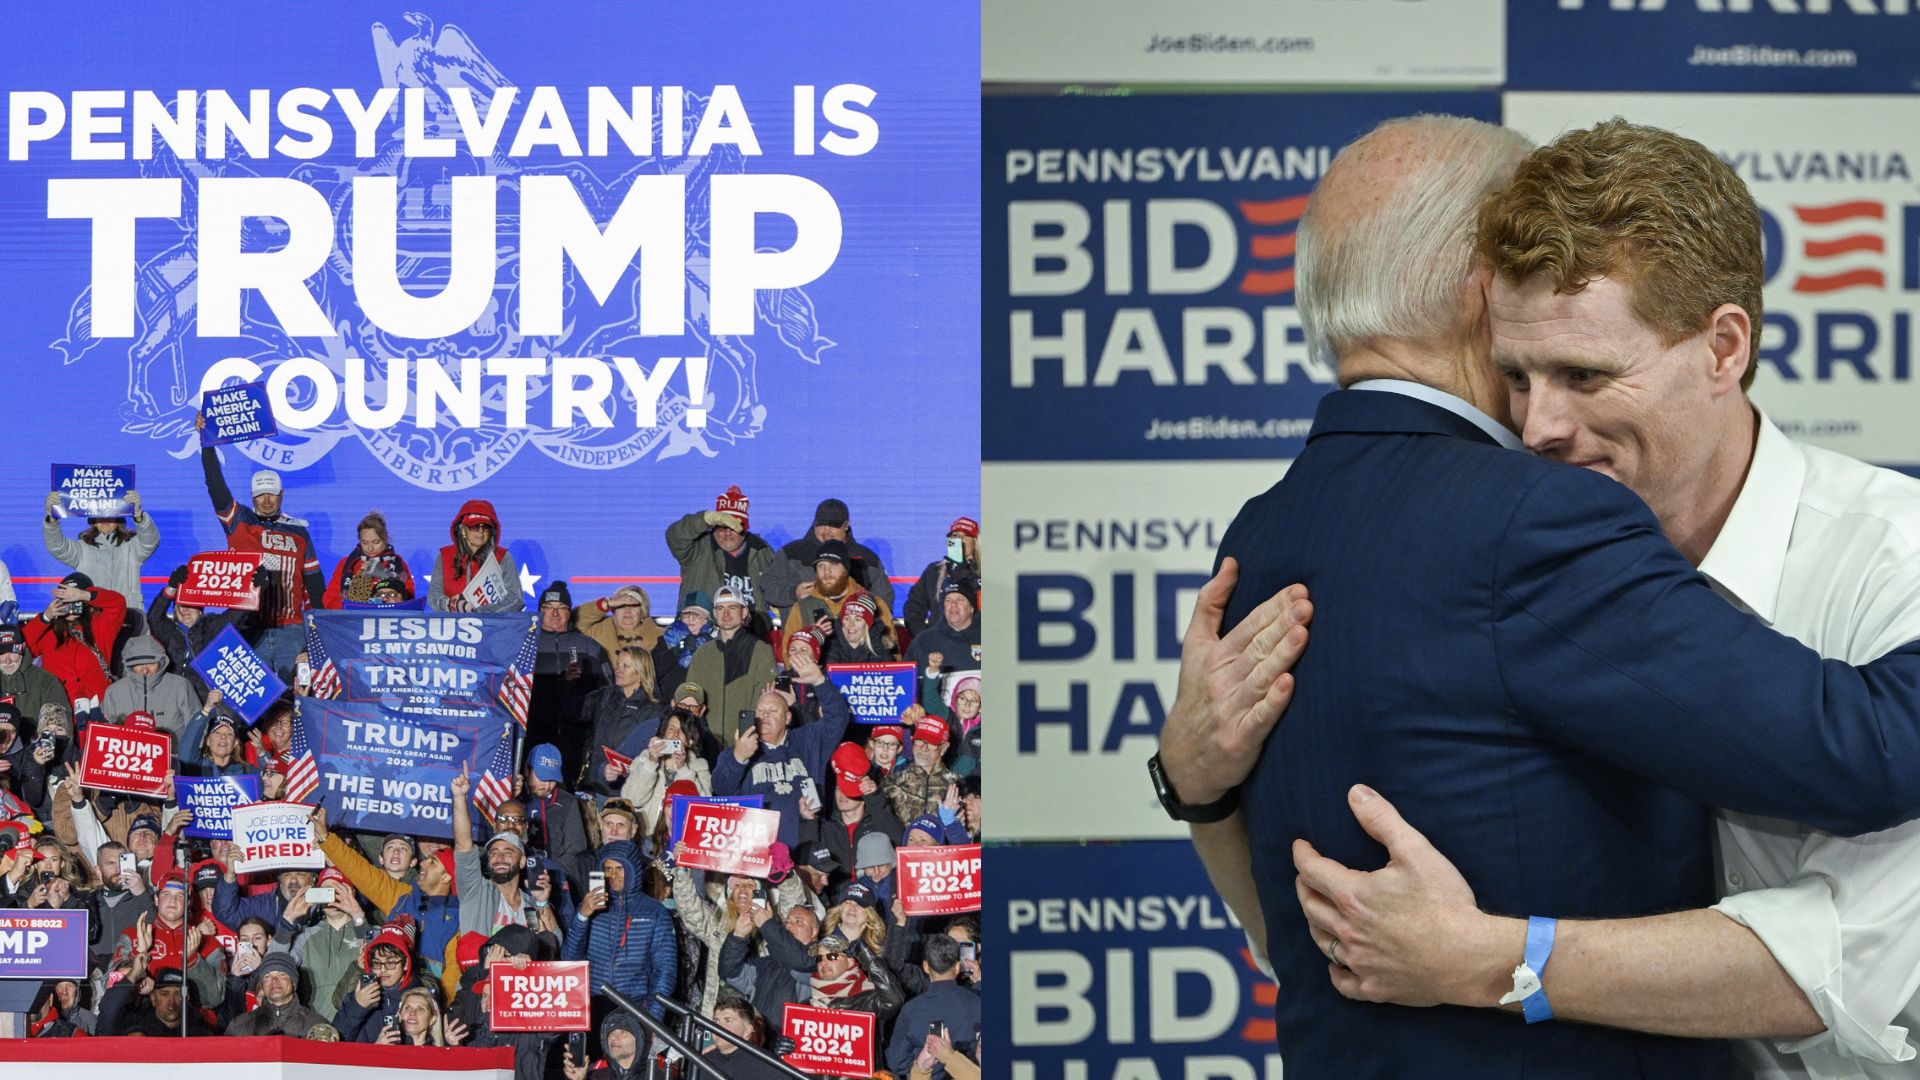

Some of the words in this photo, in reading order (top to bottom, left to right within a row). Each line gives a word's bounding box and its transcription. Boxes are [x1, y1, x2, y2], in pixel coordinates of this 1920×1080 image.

[1145, 34, 1314, 53] JoeBiden.com
[1688, 45, 1856, 67] JoeBiden.com
[8, 85, 763, 161] PENNSYLVANIA
[793, 83, 880, 157] IS
[1006, 146, 1332, 183] PENNSYLVANI
[1726, 151, 1911, 181] YLVANIA
[1008, 194, 1312, 296] BIDE
[47, 174, 843, 339] TRUMP
[1009, 305, 1338, 388] HARR
[211, 390, 248, 406] MAKE
[206, 399, 262, 418] AMERICA
[215, 411, 256, 427] GREAT
[217, 421, 261, 438] AGAIN!
[370, 433, 479, 485] LIBERTY
[485, 431, 522, 472] AND
[73, 468, 113, 478] MAKE
[61, 478, 124, 489] AMERICA
[69, 488, 116, 499] GREAT
[261, 530, 298, 553] USA
[1014, 519, 1221, 551] PENNSYL
[191, 560, 254, 576] TRUMP
[196, 574, 243, 590] 2024
[359, 617, 484, 644] JESUS
[364, 642, 383, 654] IS
[385, 642, 412, 655] MY
[415, 643, 477, 659] SAVIOR
[218, 645, 266, 698] AMERICA
[234, 644, 267, 681] MAKE
[216, 659, 254, 698] GREAT
[364, 665, 478, 689] TRUMP
[851, 675, 894, 685] MAKE
[206, 667, 247, 707] AGAIN!
[840, 685, 906, 696] AMERICA
[409, 696, 436, 704] 2024
[847, 695, 897, 706] GREAT
[848, 706, 898, 716] AGAIN!
[341, 719, 460, 753] TRUMP
[95, 736, 164, 759] TRUMP
[346, 744, 368, 752] MAKE
[369, 746, 402, 755] AMERICA
[404, 750, 428, 758] GREAT
[429, 753, 453, 761] AGAIN!
[102, 752, 154, 774] 2024
[386, 757, 414, 767] 2024
[107, 771, 131, 779] TRUMP
[142, 774, 163, 783] 88022
[193, 783, 235, 795] MAKE
[324, 772, 375, 796] THE
[381, 778, 452, 804] WORL
[186, 794, 250, 807] AMERICA
[341, 796, 404, 816] NEEDS
[409, 803, 449, 820] YOU
[195, 807, 233, 819] GREA
[196, 818, 233, 830] AGAI
[247, 816, 269, 829] JOE
[245, 827, 307, 843] YOU'RE
[246, 843, 312, 861] FIRED!
[906, 858, 981, 878] TRUMP
[918, 875, 974, 894] 2024
[906, 895, 924, 903] TEXT
[926, 894, 952, 902] TRUMP
[14, 919, 29, 928] TO
[30, 919, 63, 928] 88022
[1008, 896, 1241, 934] PENNSYL
[14, 957, 42, 965] AGAIN!
[499, 975, 580, 992] TRUMP
[510, 992, 568, 1009] 2024
[1009, 946, 1278, 1047] BID
[791, 1018, 864, 1041] TRUMP
[800, 1036, 854, 1057] 2024
[789, 1052, 806, 1060] TEXT
[807, 1054, 832, 1063] TRUMP
